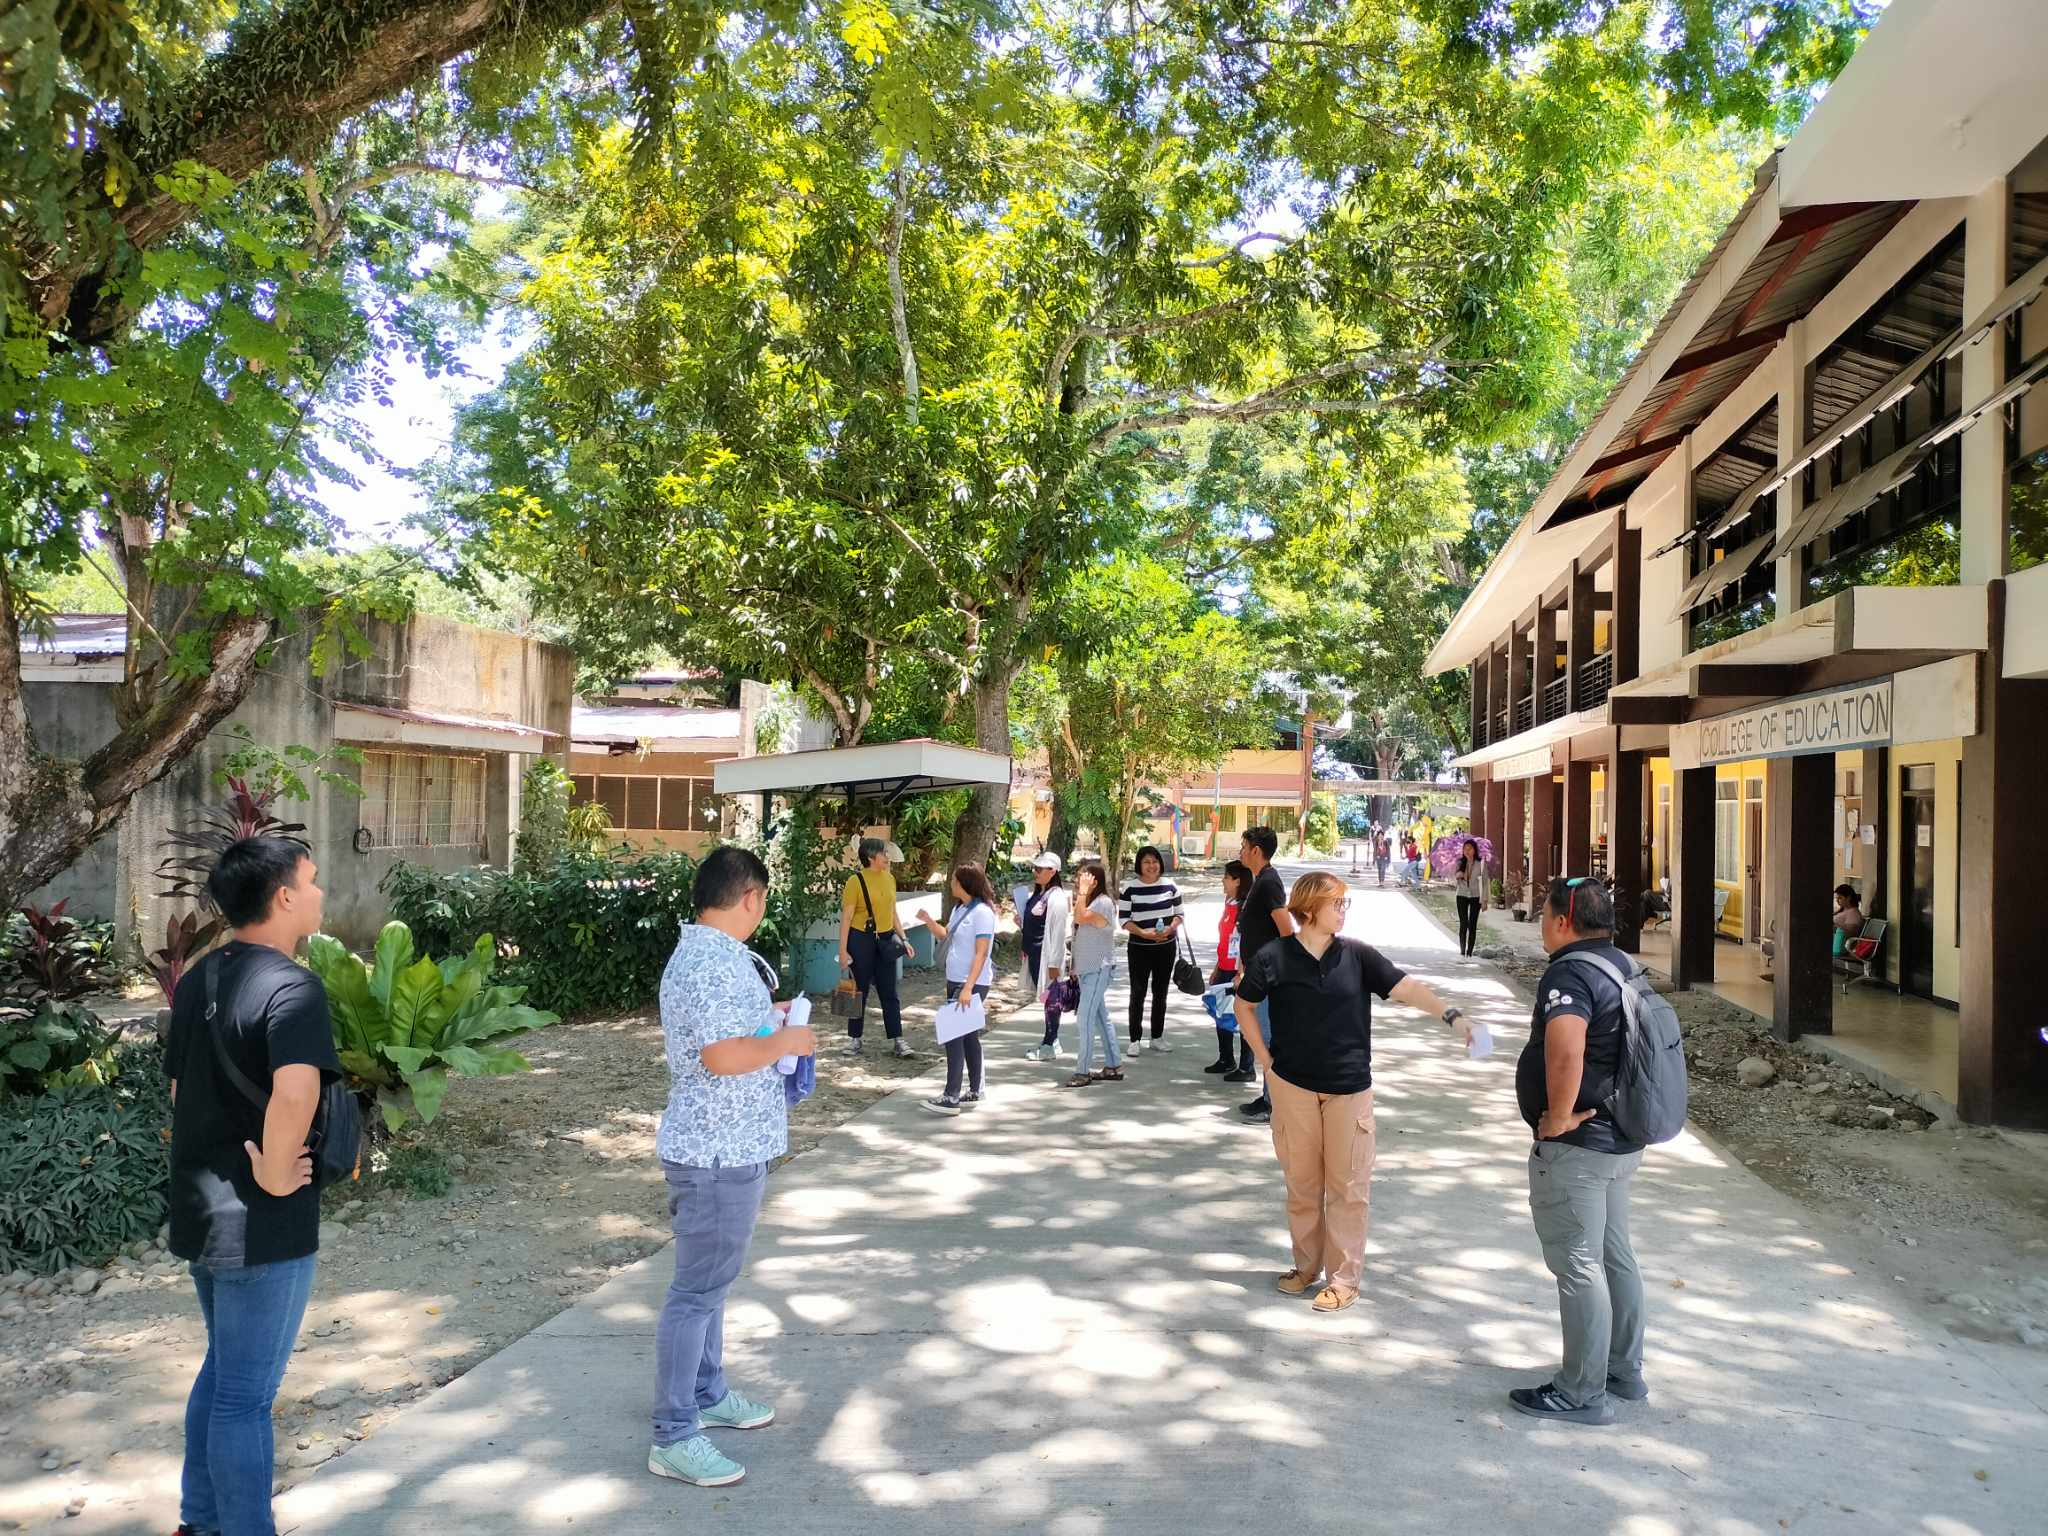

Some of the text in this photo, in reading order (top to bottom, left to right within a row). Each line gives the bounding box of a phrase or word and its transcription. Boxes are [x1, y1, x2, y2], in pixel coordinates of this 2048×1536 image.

[1702, 690, 1888, 756] COLLEGE OF EDUCATION
